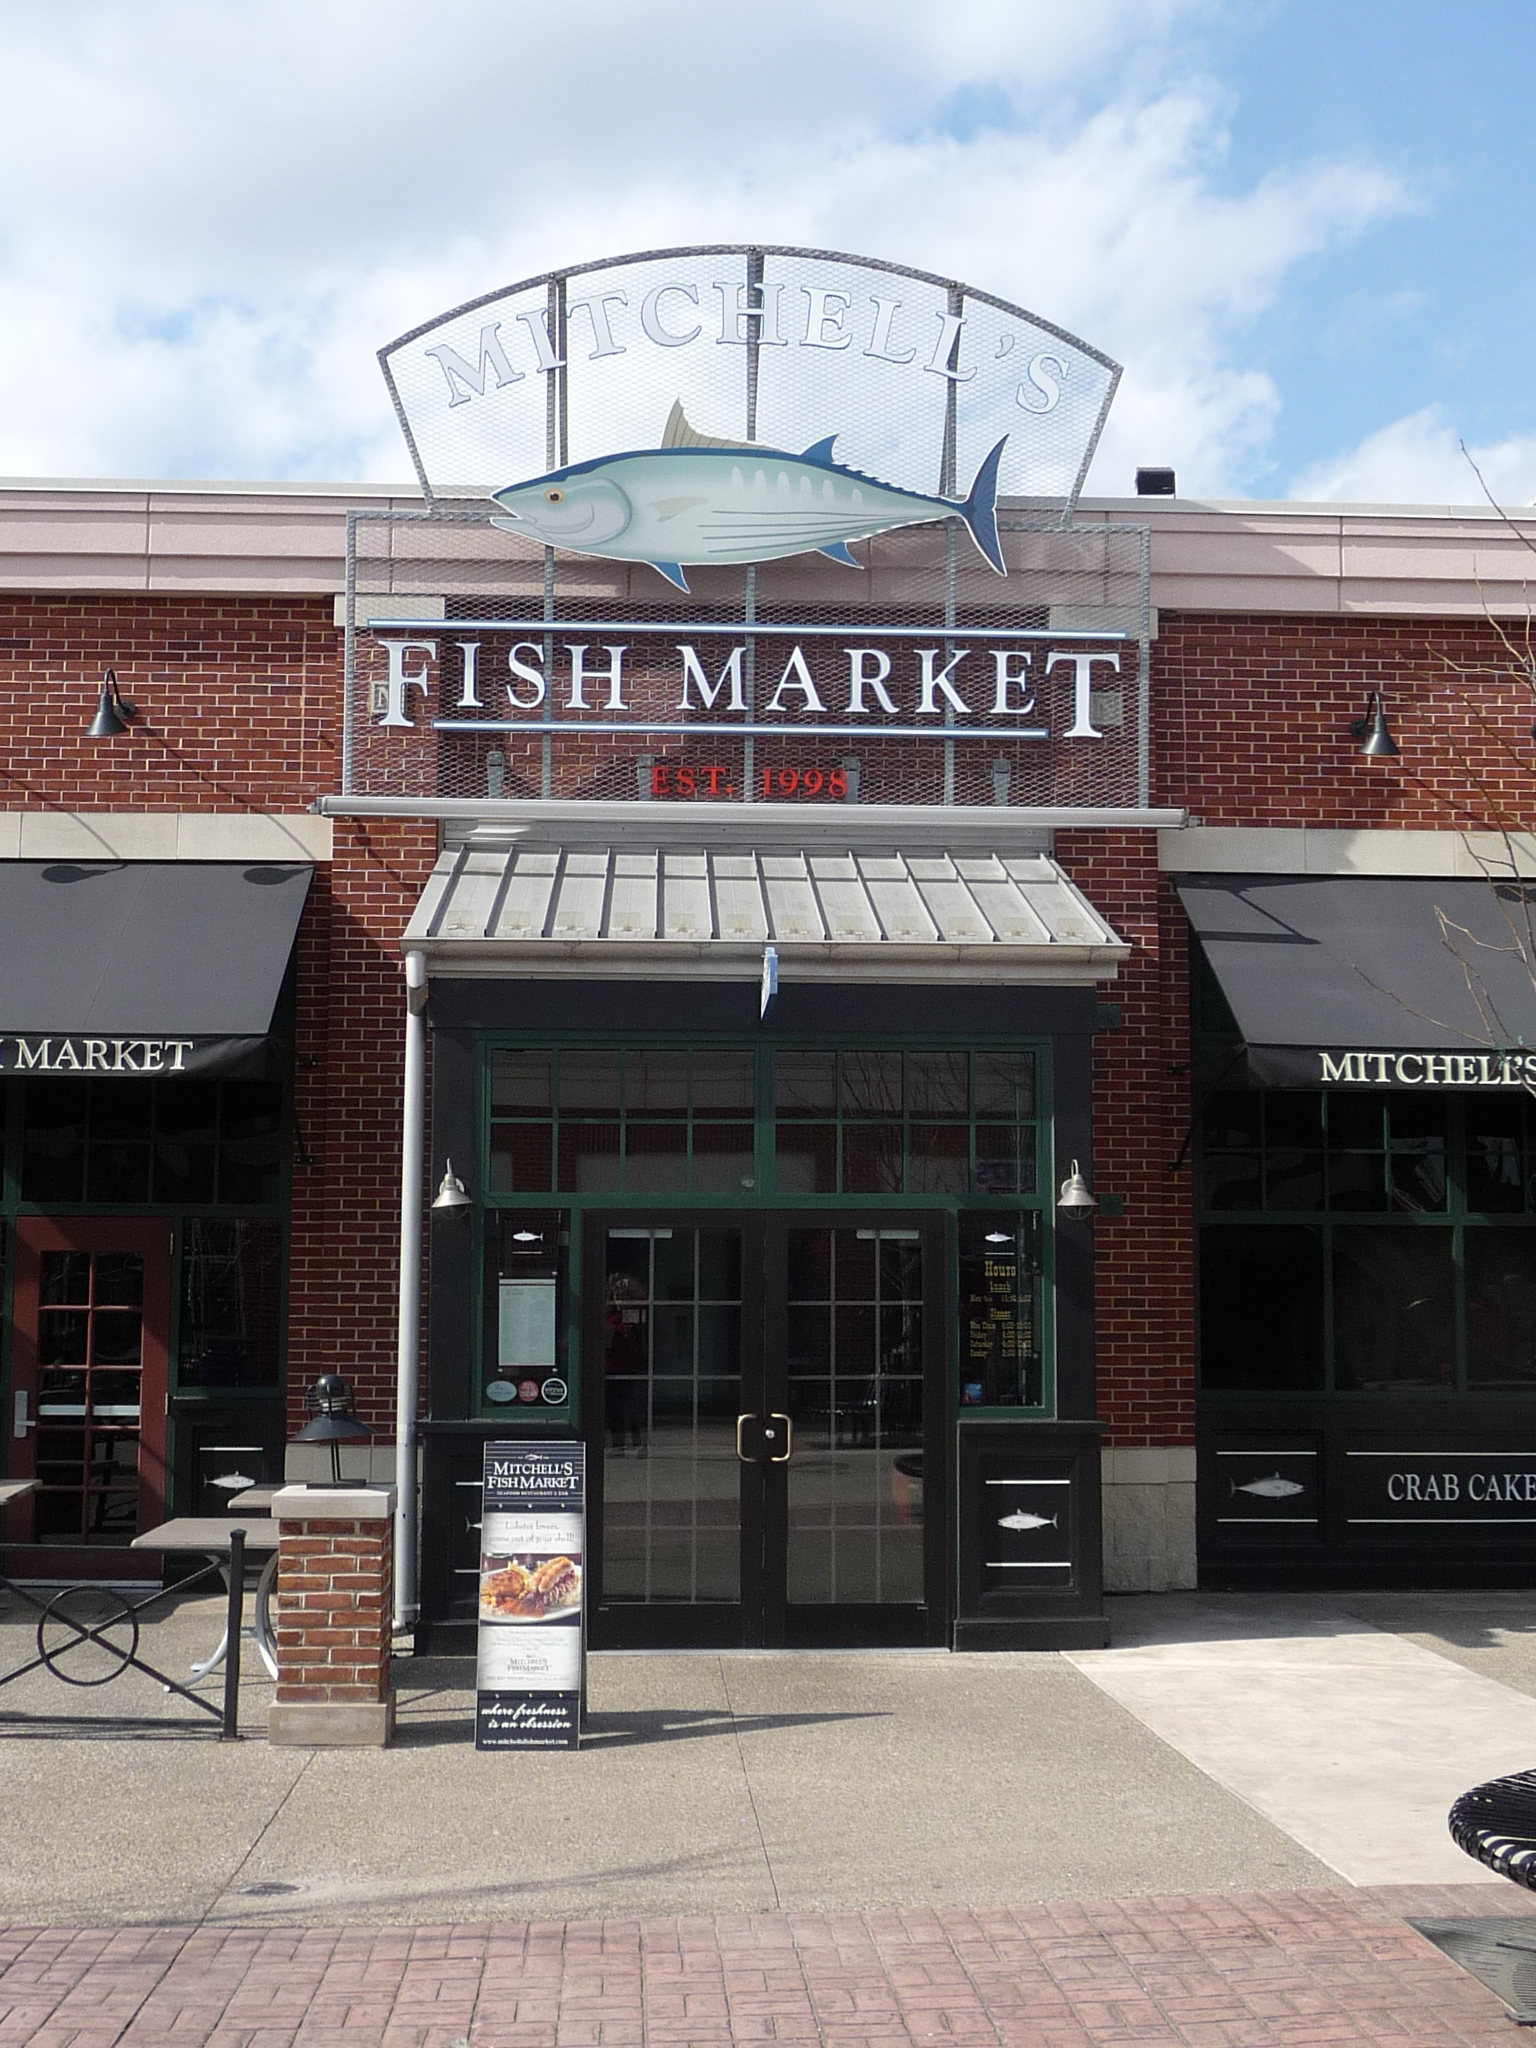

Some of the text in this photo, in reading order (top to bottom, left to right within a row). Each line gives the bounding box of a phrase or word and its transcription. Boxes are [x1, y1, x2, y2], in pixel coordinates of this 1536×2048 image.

[425, 280, 1071, 415] MITCHELL'S
[377, 640, 1121, 740] FISH MARKET
[651, 766, 848, 798] EST. 1998
[14, 1038, 194, 1071] MARKET
[1318, 1052, 1536, 1086] MITCHELL'S
[984, 1260, 1016, 1277] Hours
[493, 1461, 573, 1476] MITCHELL'S
[1387, 1473, 1536, 1501] CRAB CAKE
[481, 1703, 568, 1720] where freshness
[488, 1716, 573, 1729] is an obsession
